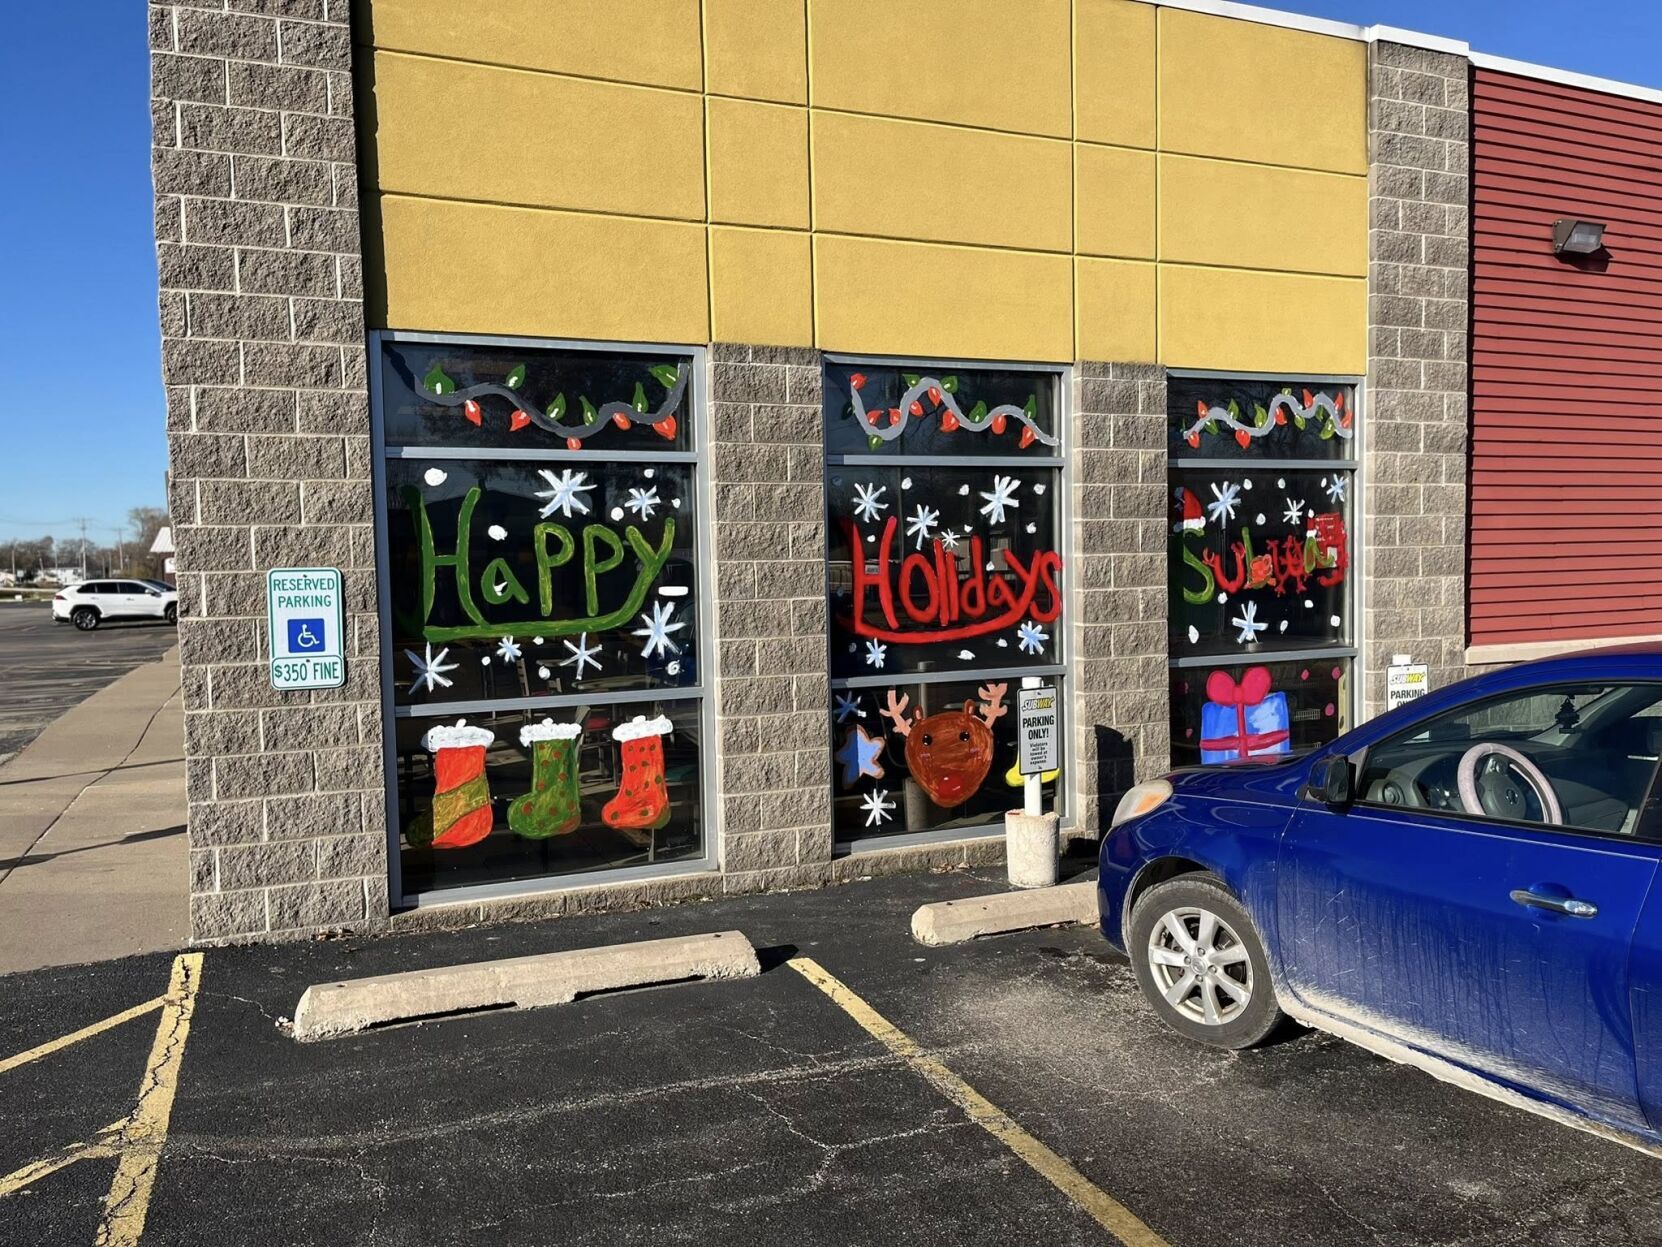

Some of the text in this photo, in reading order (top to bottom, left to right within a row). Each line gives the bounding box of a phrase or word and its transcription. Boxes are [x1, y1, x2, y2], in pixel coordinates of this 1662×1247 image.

[273, 578, 335, 591] RESERVED
[278, 595, 332, 608] PARKING
[274, 661, 340, 682] $350 FINE
[1390, 688, 1425, 699] PARKING
[1022, 697, 1055, 711] SUBWAY
[1022, 715, 1055, 729] PARKING
[1028, 728, 1049, 740] ONLY!
